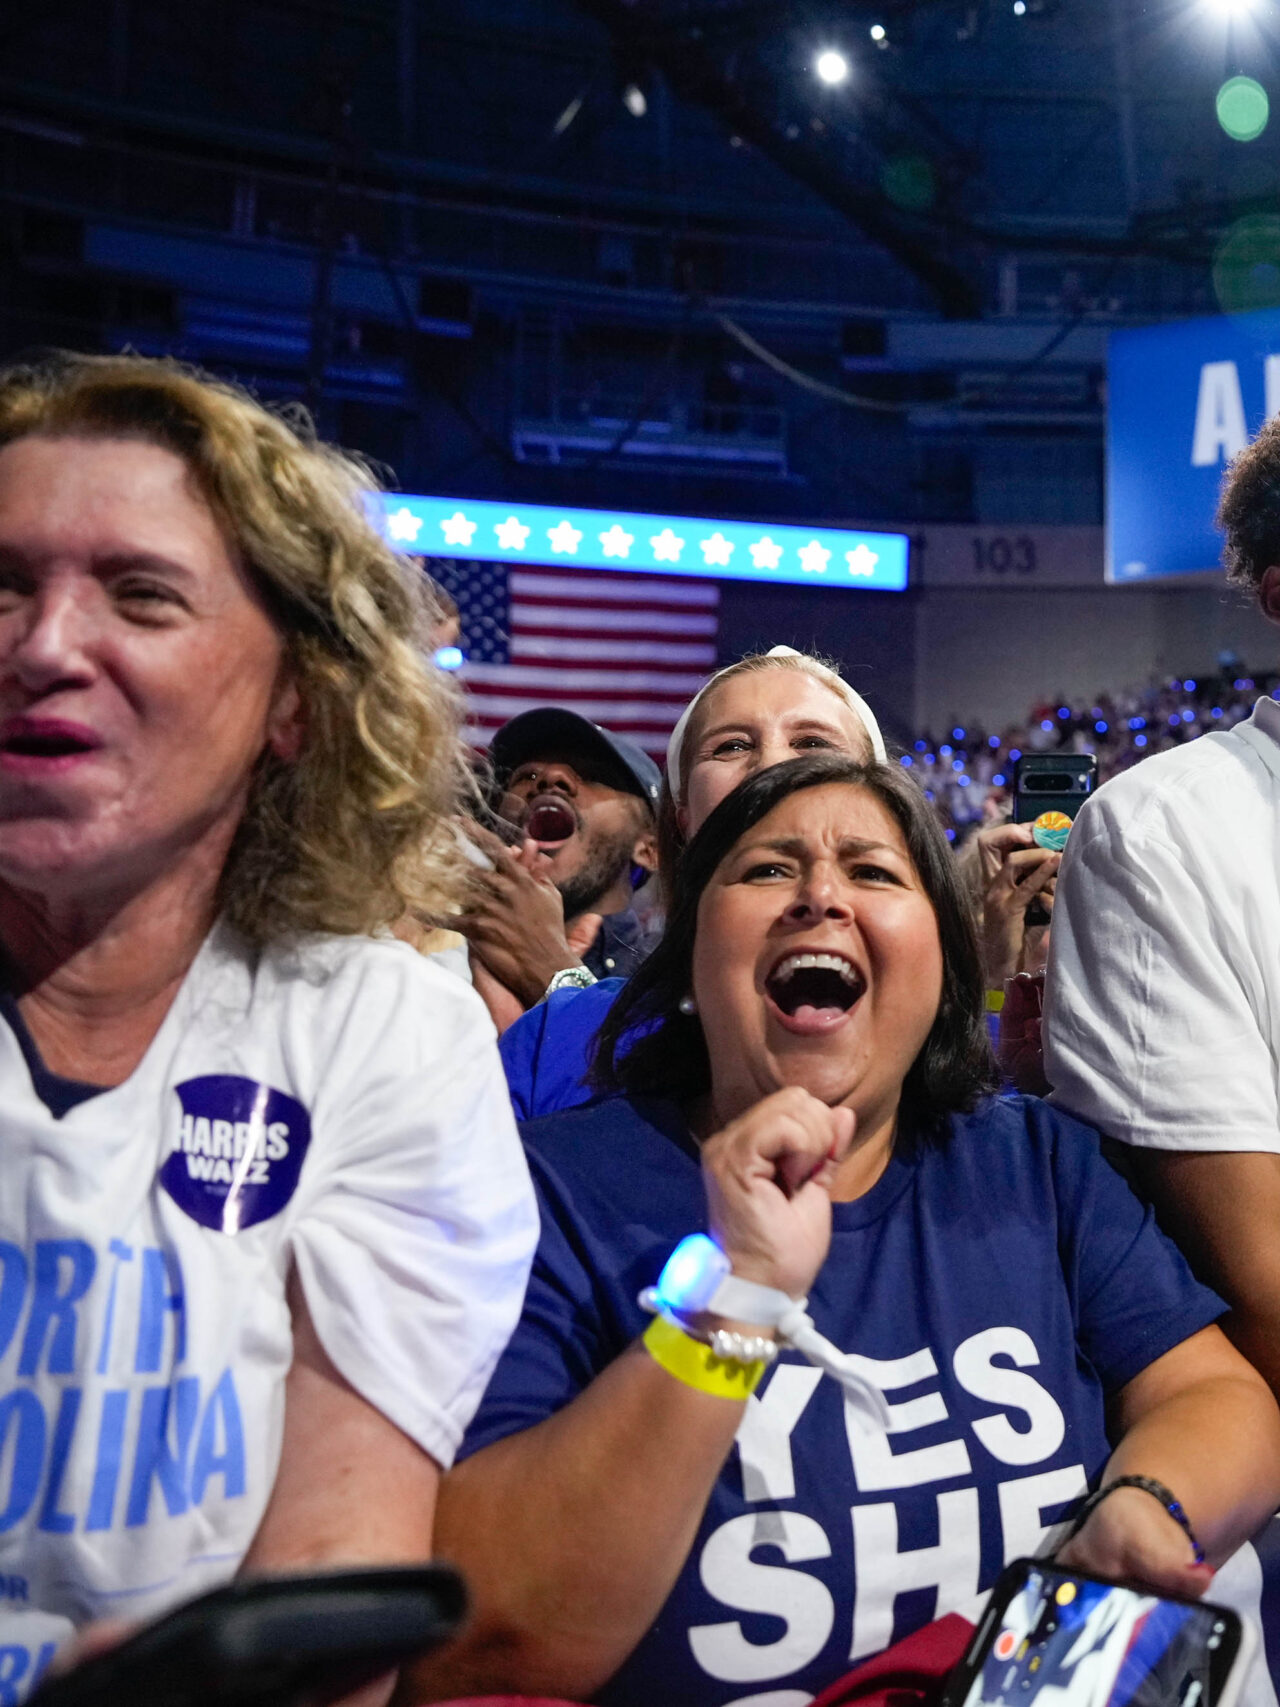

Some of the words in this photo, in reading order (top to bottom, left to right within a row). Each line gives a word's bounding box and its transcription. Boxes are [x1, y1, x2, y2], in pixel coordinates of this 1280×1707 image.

[1191, 361, 1247, 467] A
[971, 536, 1037, 574] 103
[173, 1114, 290, 1161] HARRIS
[0, 1238, 187, 1376] RTH
[0, 1366, 247, 1534] OLINA
[734, 1326, 1065, 1503] YES
[687, 1464, 1089, 1683] SHE
